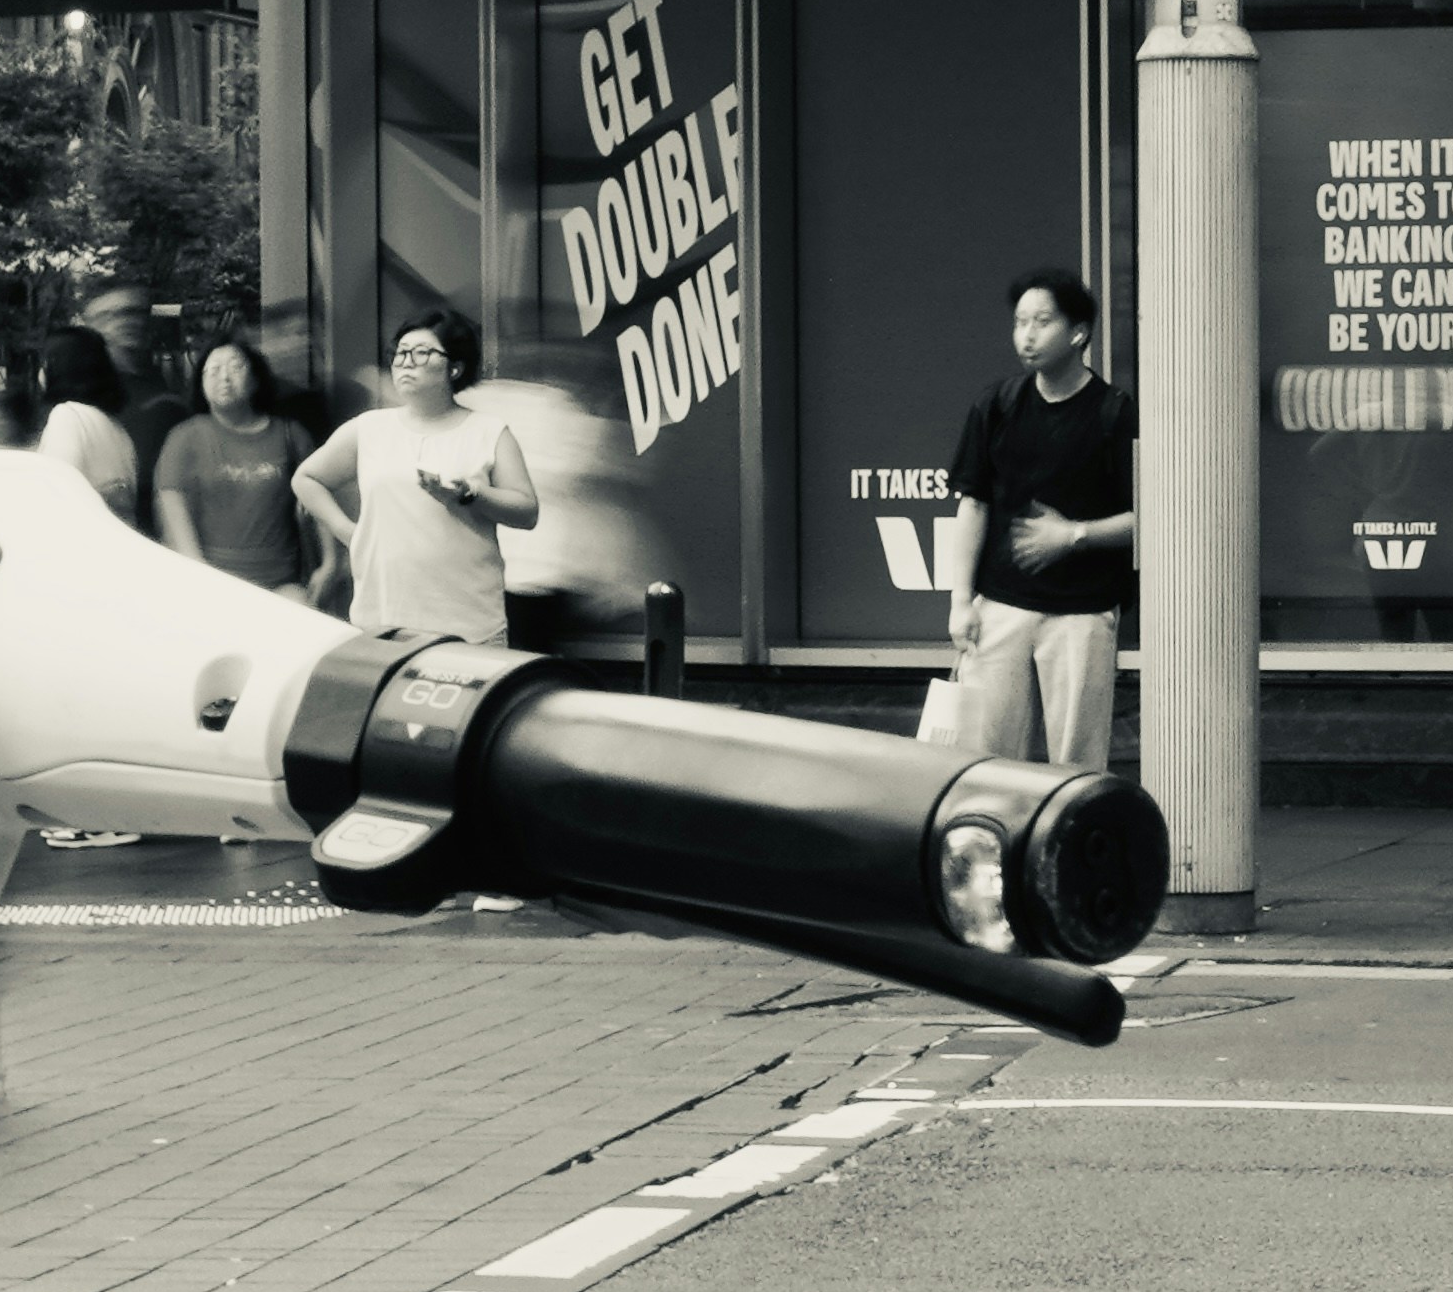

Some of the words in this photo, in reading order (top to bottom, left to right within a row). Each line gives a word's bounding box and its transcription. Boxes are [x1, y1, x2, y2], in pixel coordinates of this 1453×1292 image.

[1328, 140, 1423, 179] WHEN
[560, 81, 739, 338] DOUBLE
[1315, 181, 1426, 222] COMES
[1333, 269, 1384, 309] WE
[616, 243, 740, 456] DONE
[1328, 313, 1369, 352] BE
[851, 469, 872, 499] IT
[877, 468, 949, 500] TAKES
[1364, 521, 1395, 536] TAKES
[1404, 521, 1438, 536] LITTLE
[402, 679, 463, 709] GO
[338, 821, 410, 848] GO
